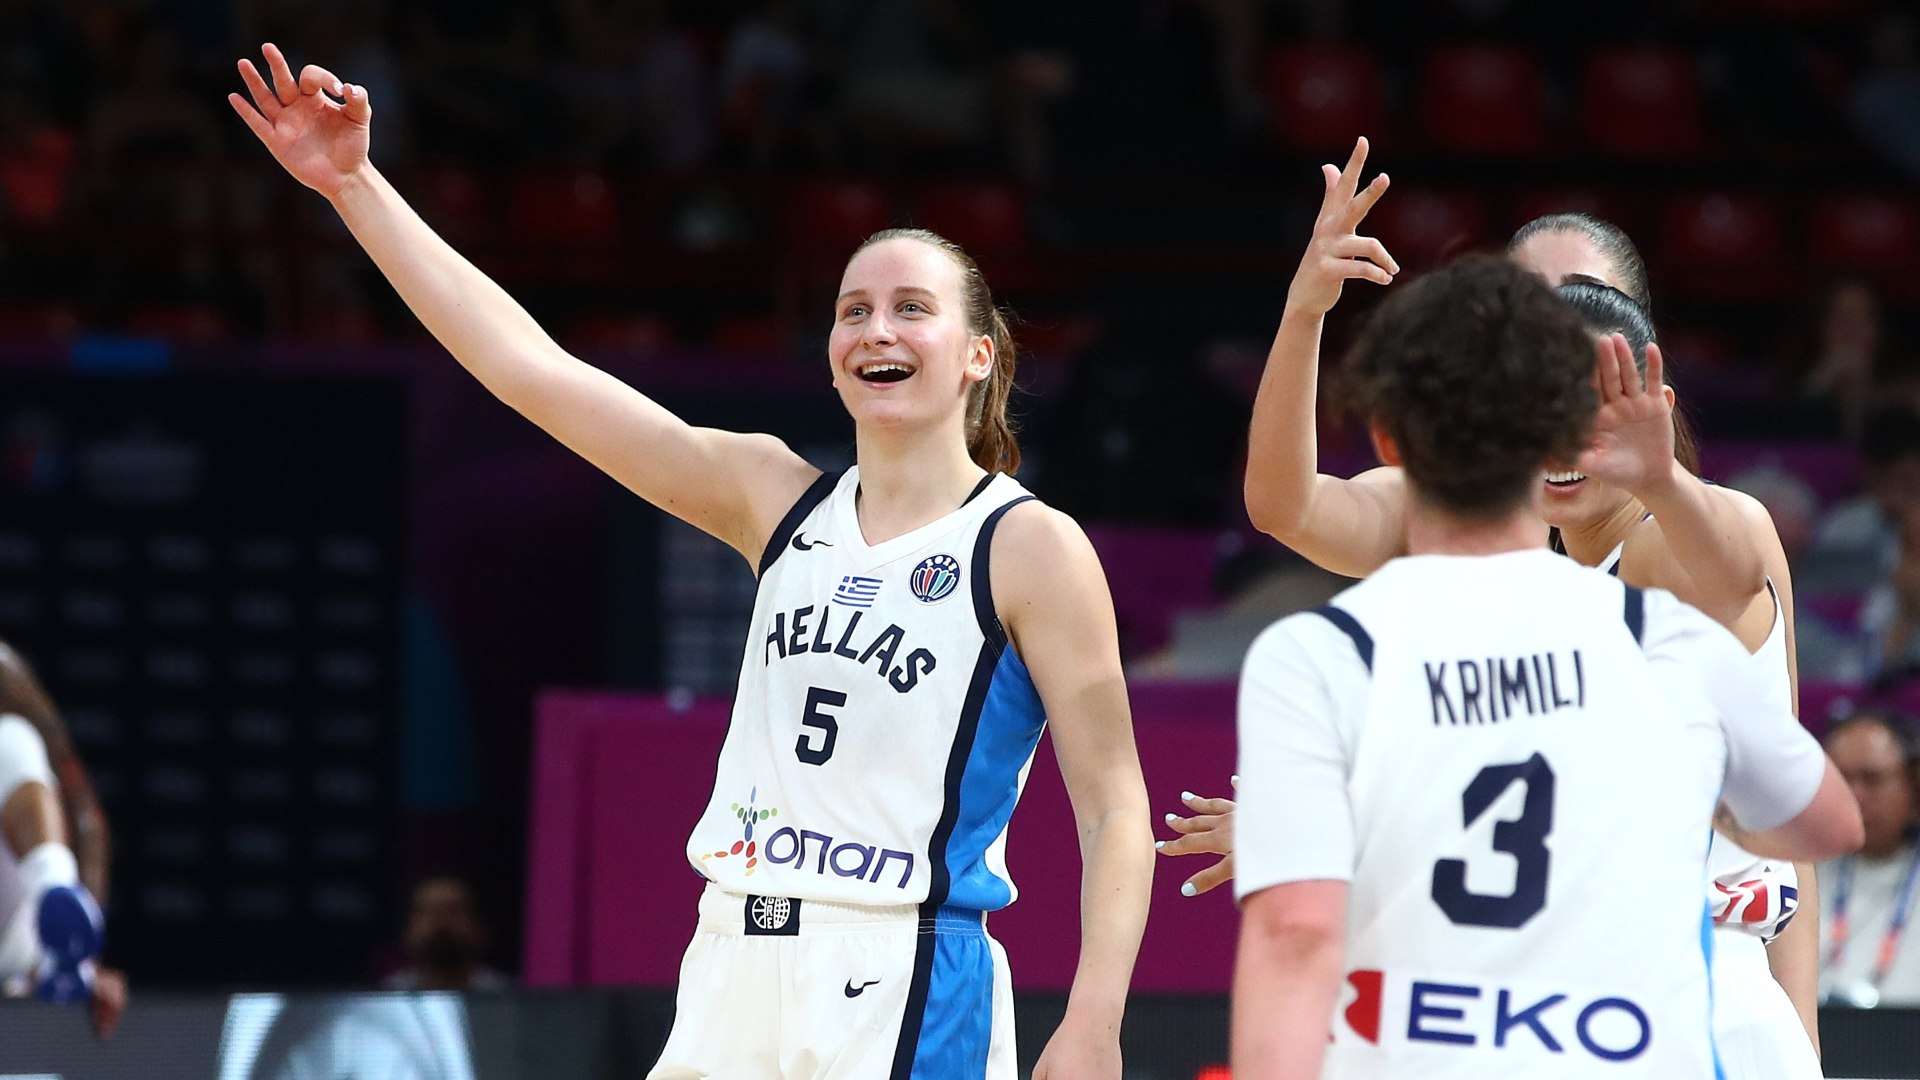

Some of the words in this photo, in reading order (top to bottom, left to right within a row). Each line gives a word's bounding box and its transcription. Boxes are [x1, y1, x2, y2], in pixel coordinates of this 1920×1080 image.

[765, 604, 937, 694] HELLAS
[1424, 649, 1584, 726] KRIMILI
[795, 686, 848, 766] 5
[1431, 751, 1556, 930] 3
[1407, 981, 1652, 1062] EKO
